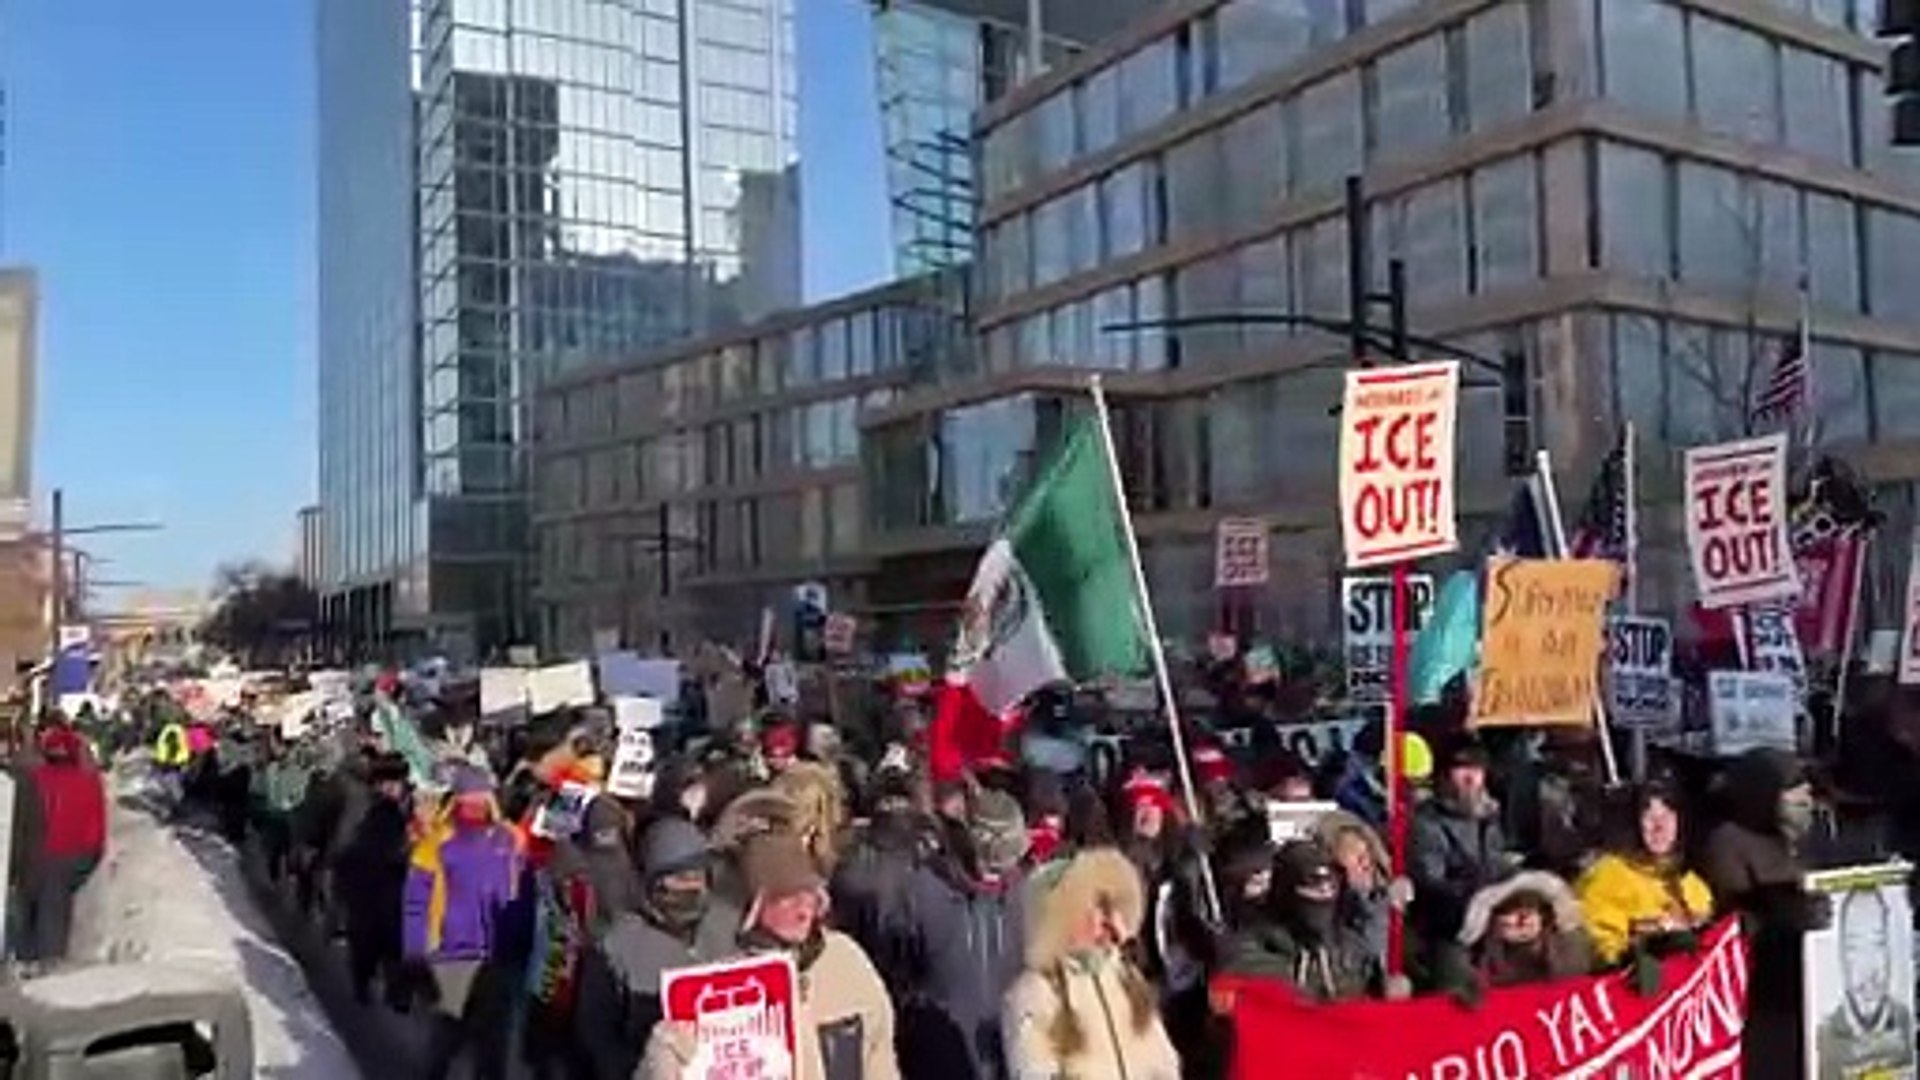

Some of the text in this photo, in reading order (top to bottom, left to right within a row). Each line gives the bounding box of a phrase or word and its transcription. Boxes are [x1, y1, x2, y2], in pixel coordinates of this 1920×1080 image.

[1354, 412, 1436, 473] ICE
[1354, 478, 1441, 539] OUT!
[1696, 480, 1771, 530] ICE
[1703, 527, 1779, 580] OUT!
[1536, 981, 1622, 1066] YA!
